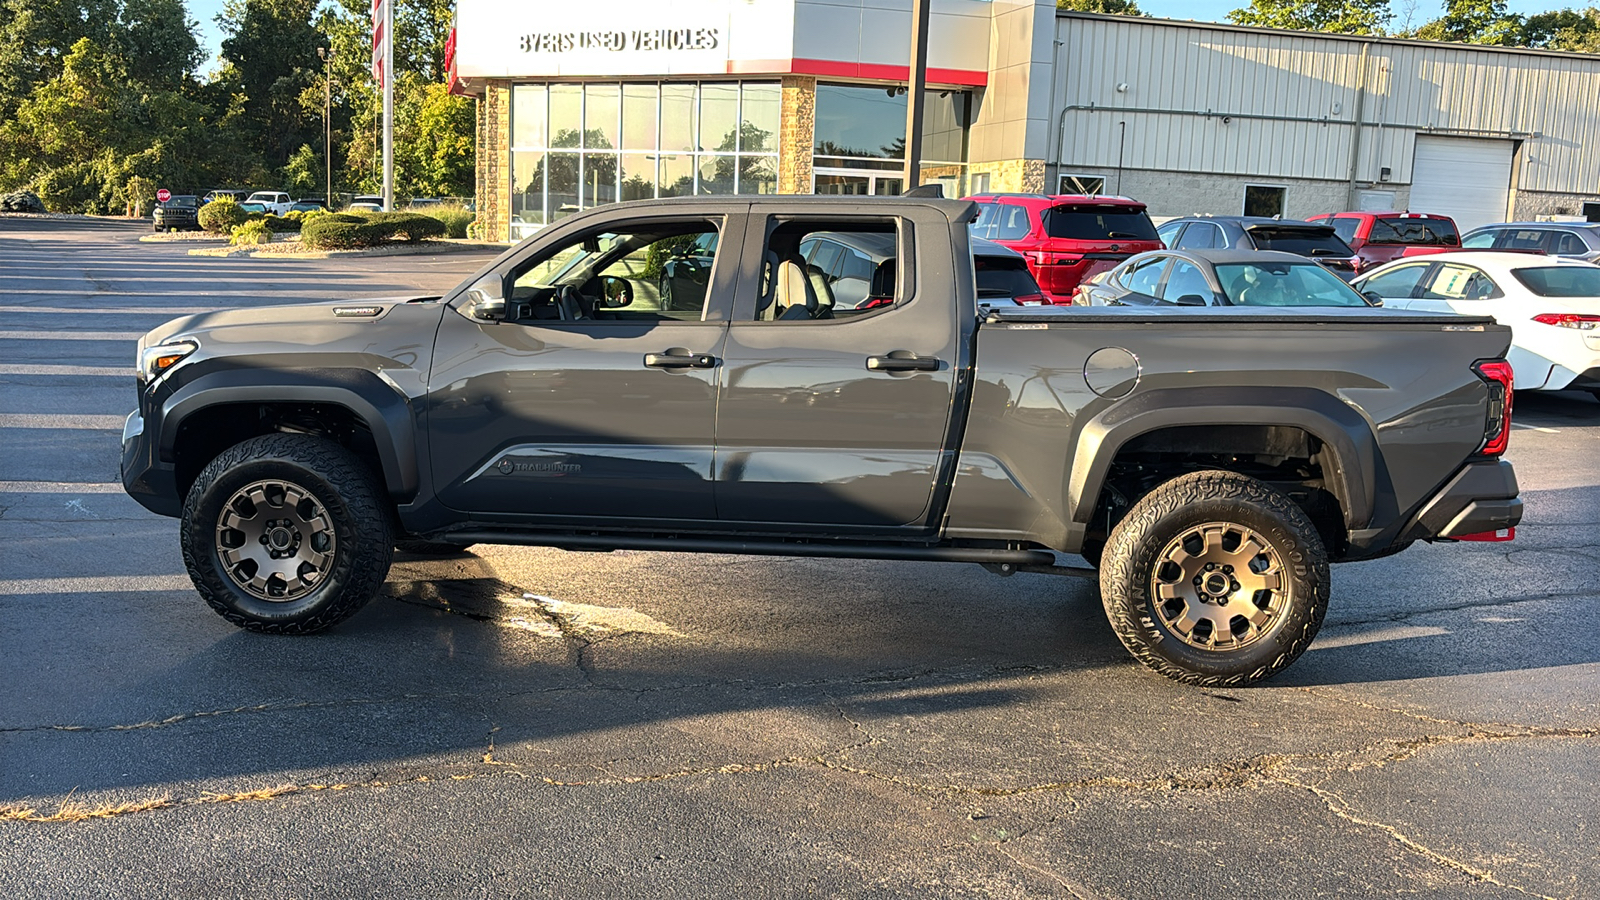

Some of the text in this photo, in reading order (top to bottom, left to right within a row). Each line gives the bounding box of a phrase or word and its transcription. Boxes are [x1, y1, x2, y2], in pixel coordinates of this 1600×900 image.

[519, 28, 719, 53] BYERS USED VEHICLES
[516, 463, 581, 472] TRAILHUNTER
[1132, 534, 1165, 645] WRANGLER
[1271, 527, 1311, 646] GOODYEAR
